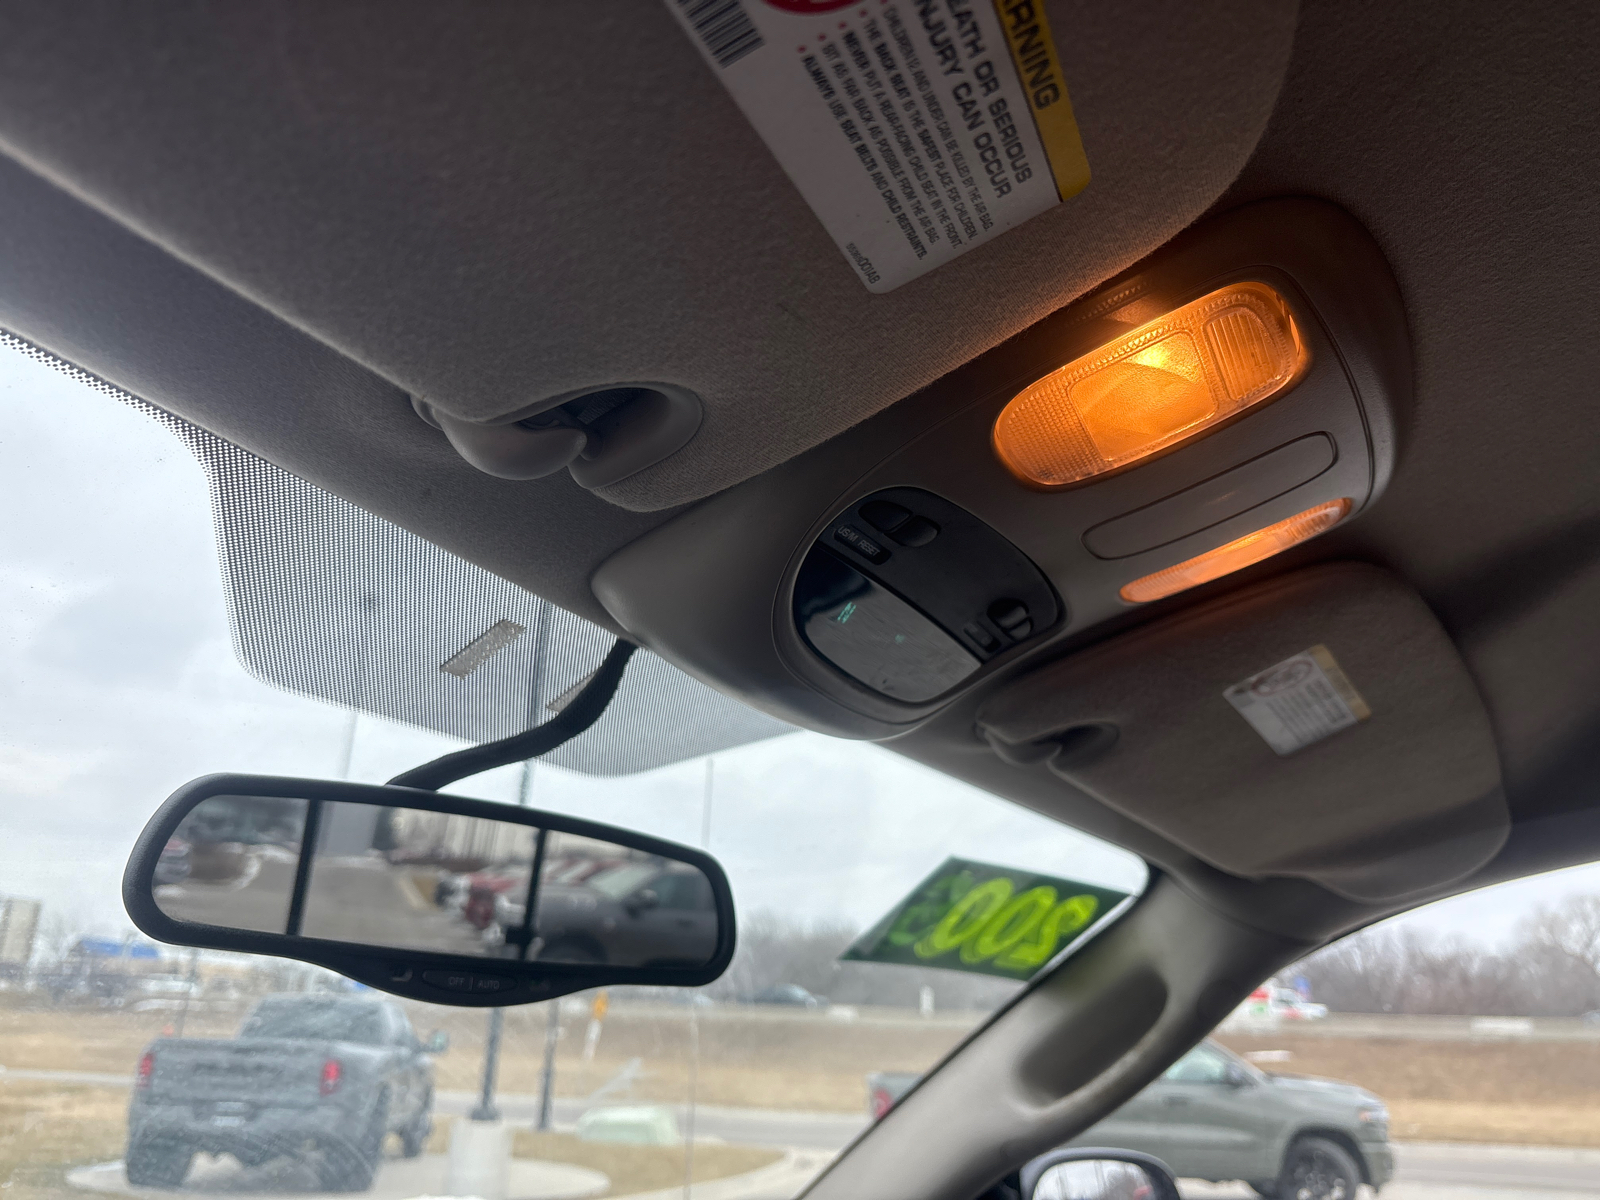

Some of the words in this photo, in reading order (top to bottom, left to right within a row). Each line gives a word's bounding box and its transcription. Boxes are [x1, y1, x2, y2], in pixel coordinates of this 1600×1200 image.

[864, 18, 882, 41] THE
[883, 7, 915, 60] CHILDREN
[821, 42, 840, 61] SIT
[842, 31, 870, 69] NEVER
[874, 42, 897, 71] BACK
[1002, 0, 1059, 108] RNING
[831, 62, 848, 78] AS
[862, 68, 882, 91] PUT
[911, 69, 930, 92] AND
[842, 77, 860, 98] FAR
[889, 72, 911, 98] SEAT
[851, 97, 875, 124] BACK
[902, 99, 915, 111] IS
[921, 90, 944, 122] UNDER
[878, 98, 915, 157] REAR-FACING
[908, 109, 925, 130] THE
[936, 120, 953, 141] CAN
[973, 59, 999, 96] OR
[987, 97, 1032, 183] SERIOUS
[867, 125, 883, 139] AS
[951, 81, 985, 131] CAN
[972, 131, 1012, 198] OCCUR
[917, 128, 942, 162] SAFEST
[944, 138, 959, 153] BE
[802, 55, 835, 99] ALWAYS
[828, 99, 847, 119] USE
[840, 118, 862, 143] SEAT
[854, 142, 877, 171] BELTS
[869, 170, 888, 190] AND
[881, 188, 902, 214] CHILD
[895, 212, 927, 260] RESTRAINTS.
[875, 137, 904, 179] POSSIBLE
[908, 155, 928, 181] CHILD
[950, 150, 970, 178] KILLED
[933, 160, 954, 188] PLACE
[961, 175, 976, 188] BY
[897, 176, 917, 201] FROM
[920, 179, 939, 199] SEAT
[945, 186, 961, 203] FOR
[967, 186, 982, 203] THE
[910, 199, 926, 217] THE
[930, 198, 943, 210] IN
[935, 207, 951, 224] THE
[973, 201, 987, 215] AIR
[917, 215, 932, 229] AIR
[953, 201, 978, 240] CHILDREN.
[978, 212, 993, 232] BAG.
[924, 226, 940, 245] BAG.
[943, 222, 963, 249] FRONT.
[857, 539, 881, 557] RESET
[478, 980, 501, 990] AUTO
